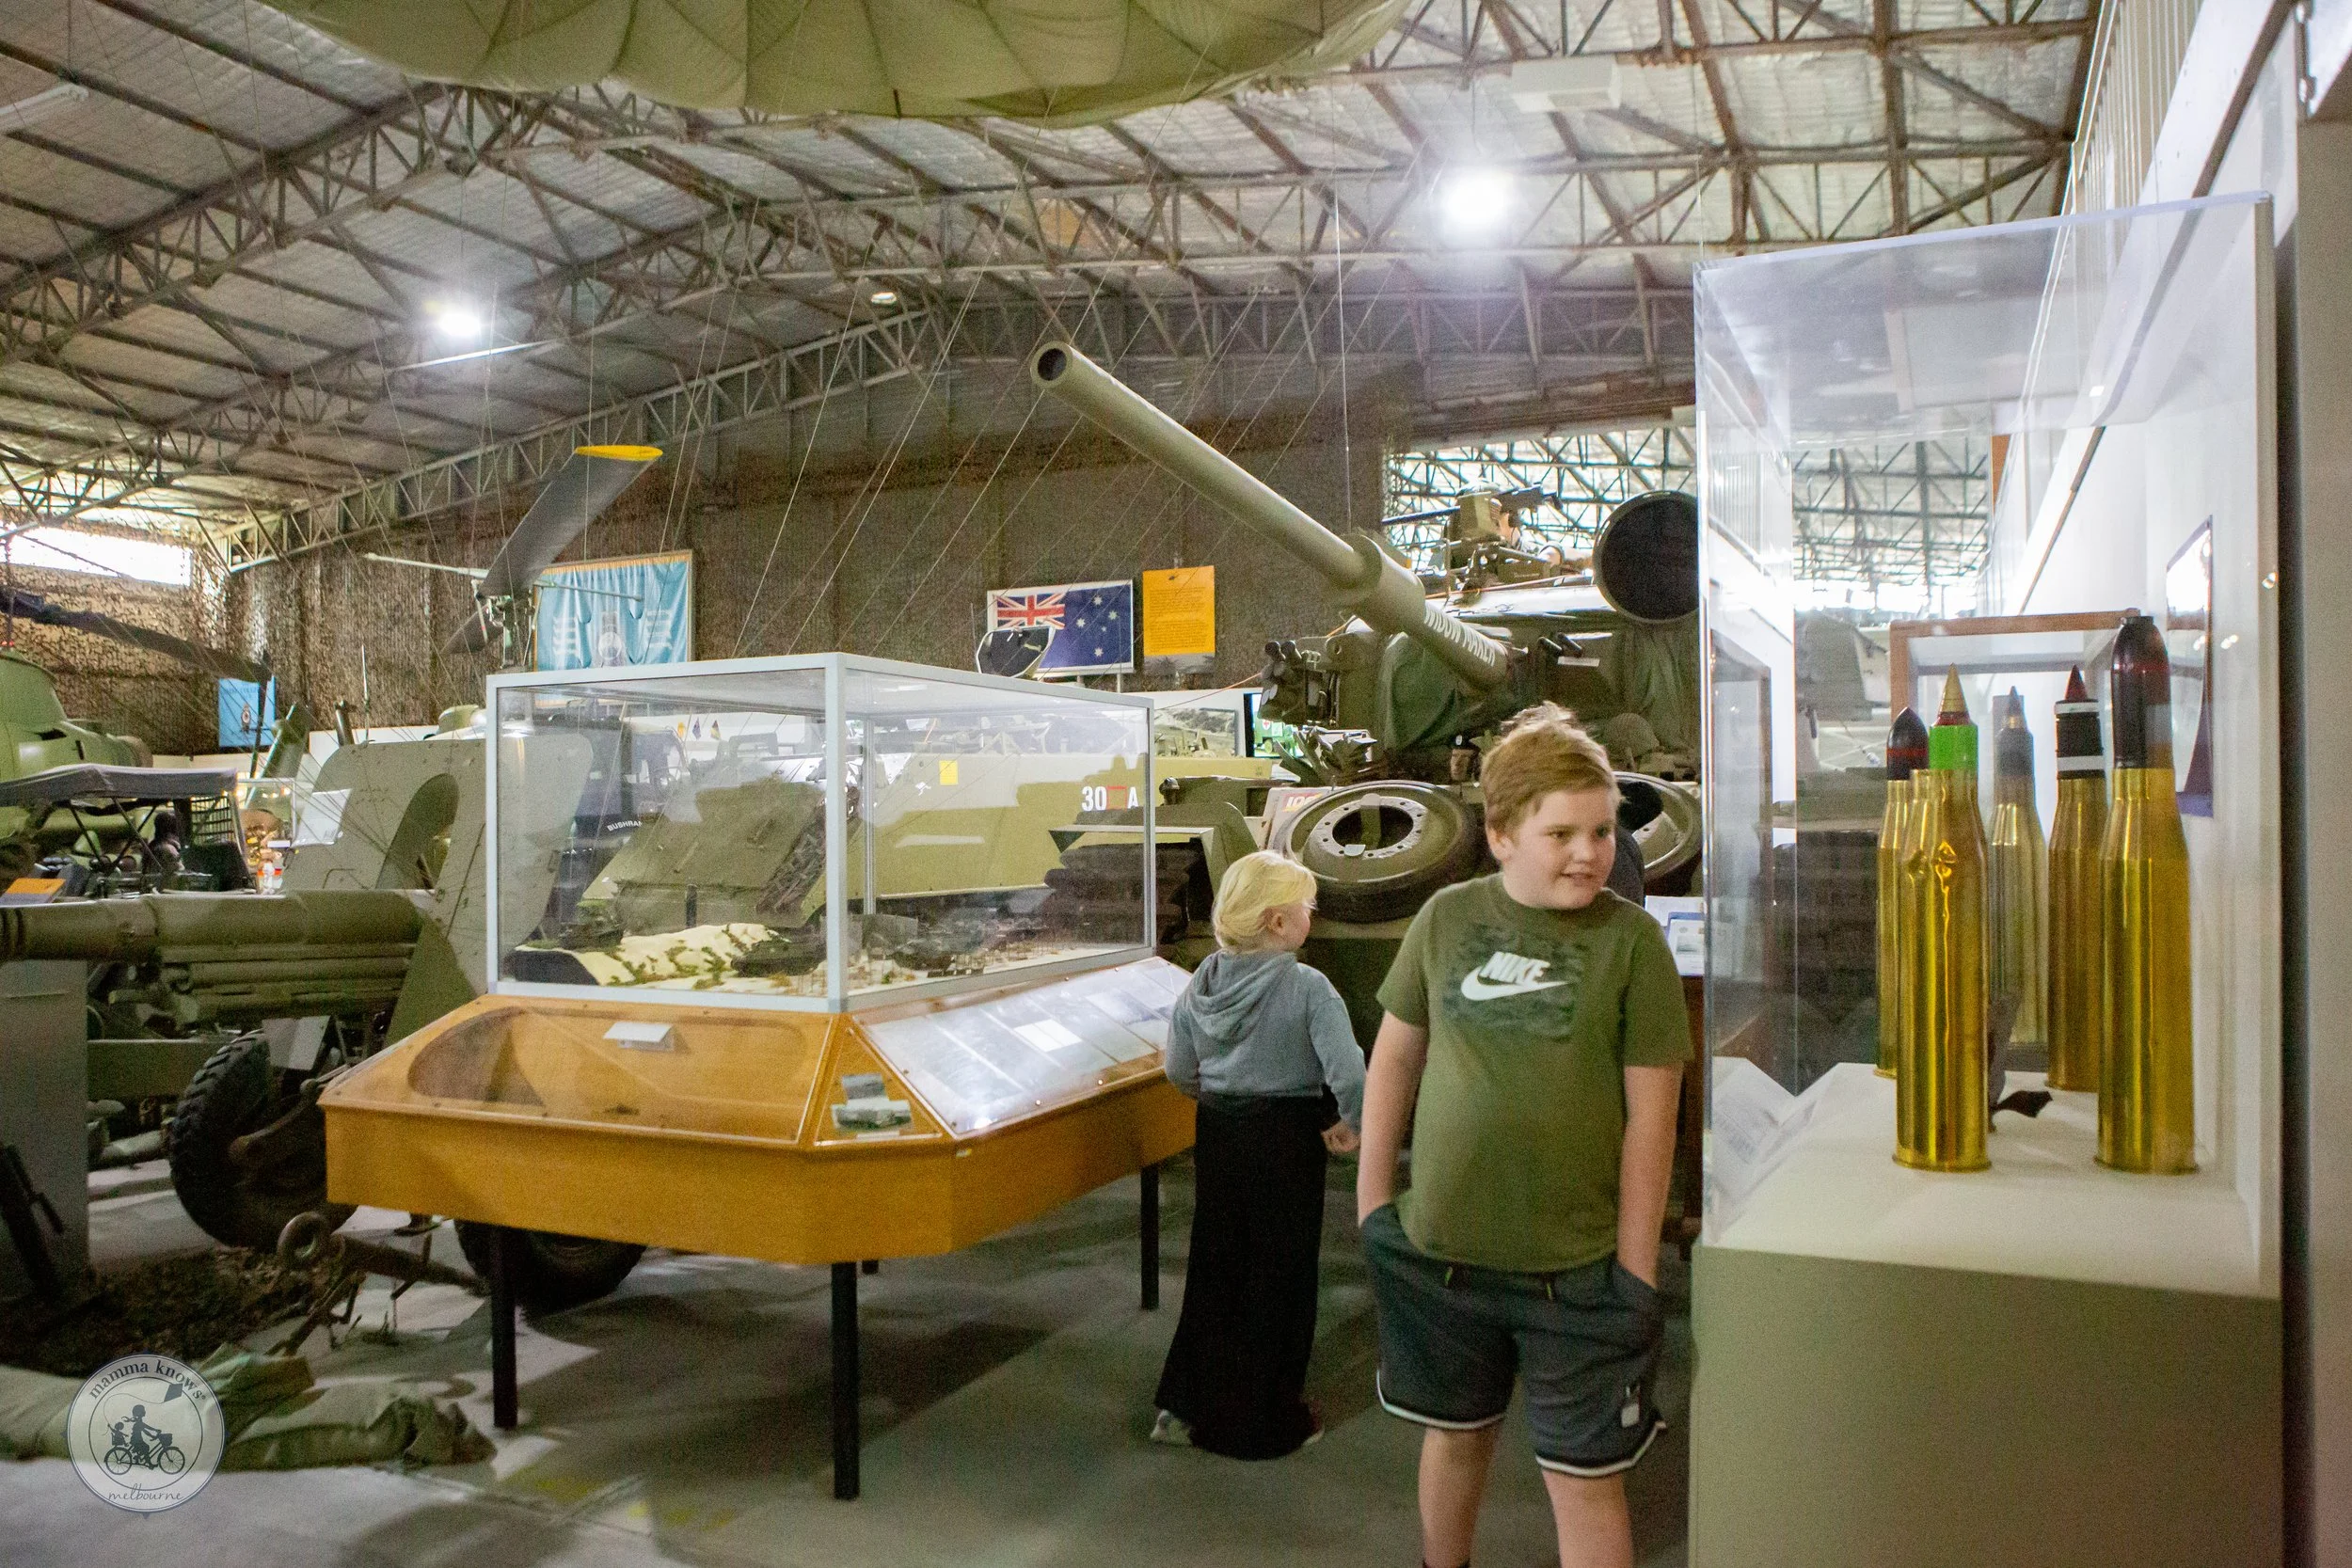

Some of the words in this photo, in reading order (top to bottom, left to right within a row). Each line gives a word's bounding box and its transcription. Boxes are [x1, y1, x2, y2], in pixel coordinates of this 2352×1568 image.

[1081, 785, 1107, 812] 30
[1127, 786, 1139, 810] A
[1479, 951, 1550, 987] NIKE
